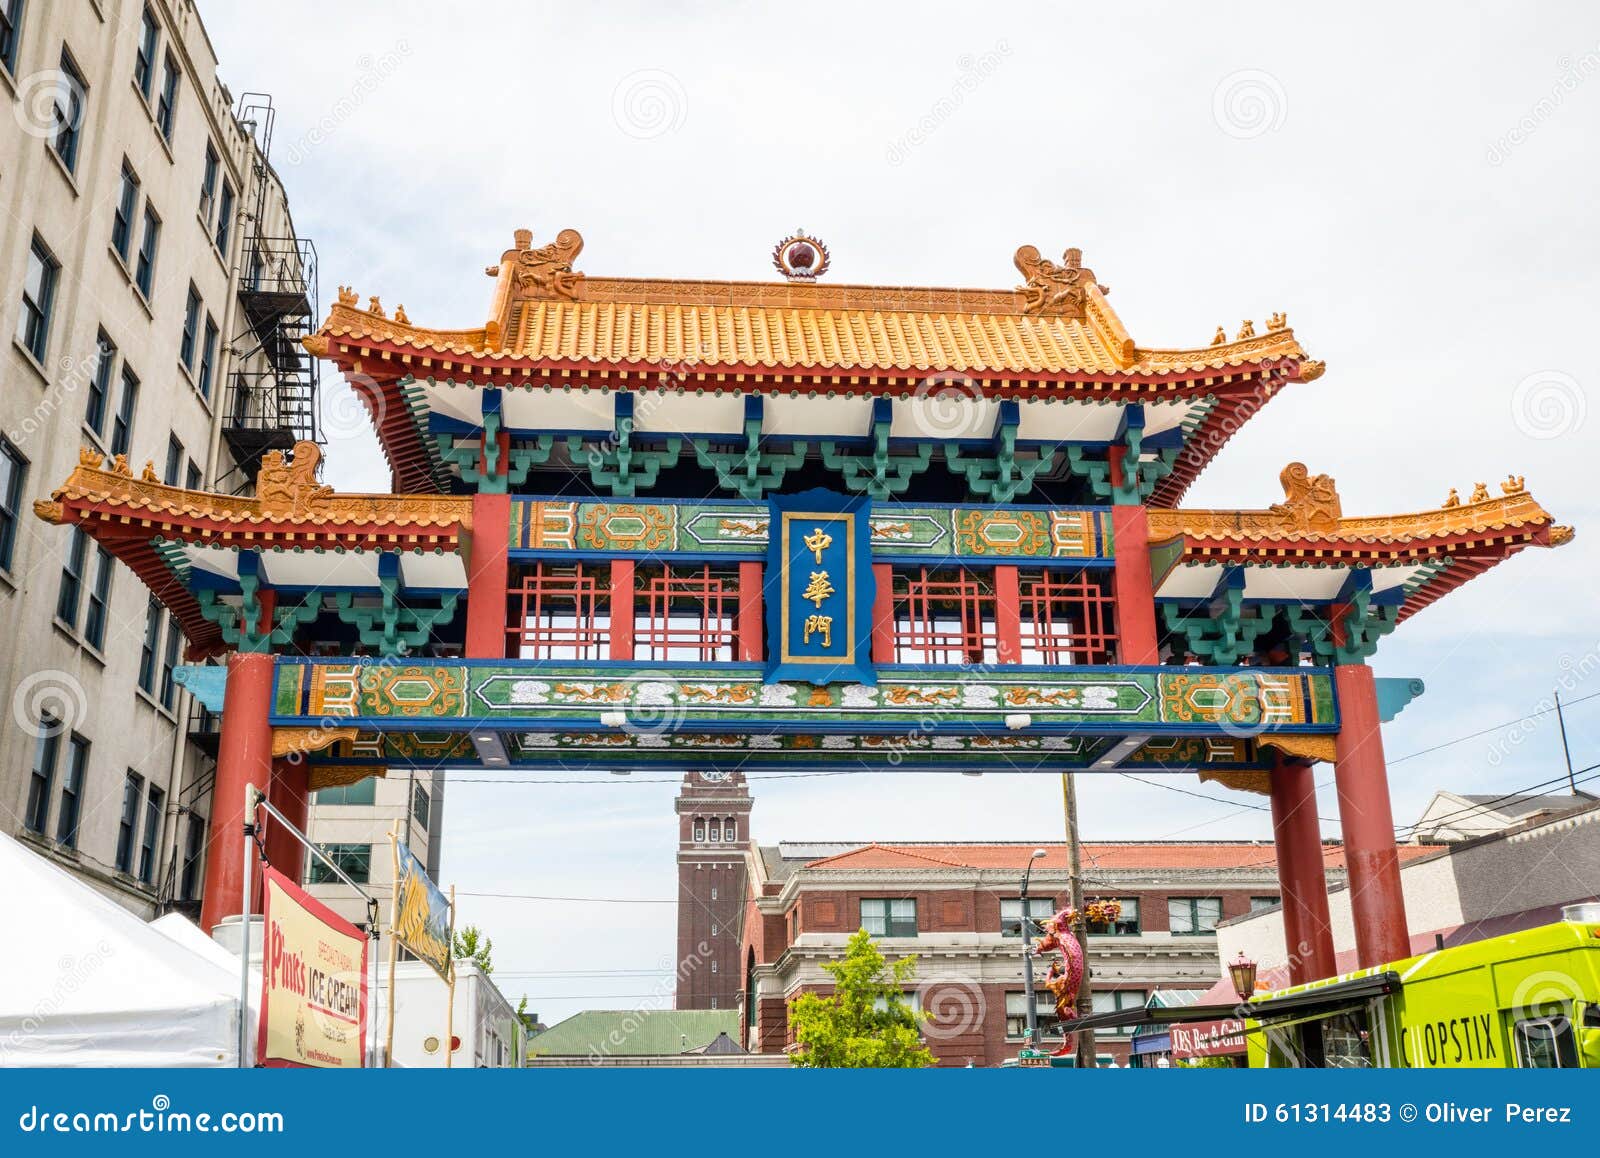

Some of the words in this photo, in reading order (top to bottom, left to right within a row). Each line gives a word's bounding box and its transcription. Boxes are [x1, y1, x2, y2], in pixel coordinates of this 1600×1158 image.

[802, 527, 835, 647] 中華門
[308, 967, 325, 1006] ICE
[327, 976, 358, 1018] CREAM
[1192, 1028, 1209, 1050] Bar
[1211, 1025, 1220, 1048] &
